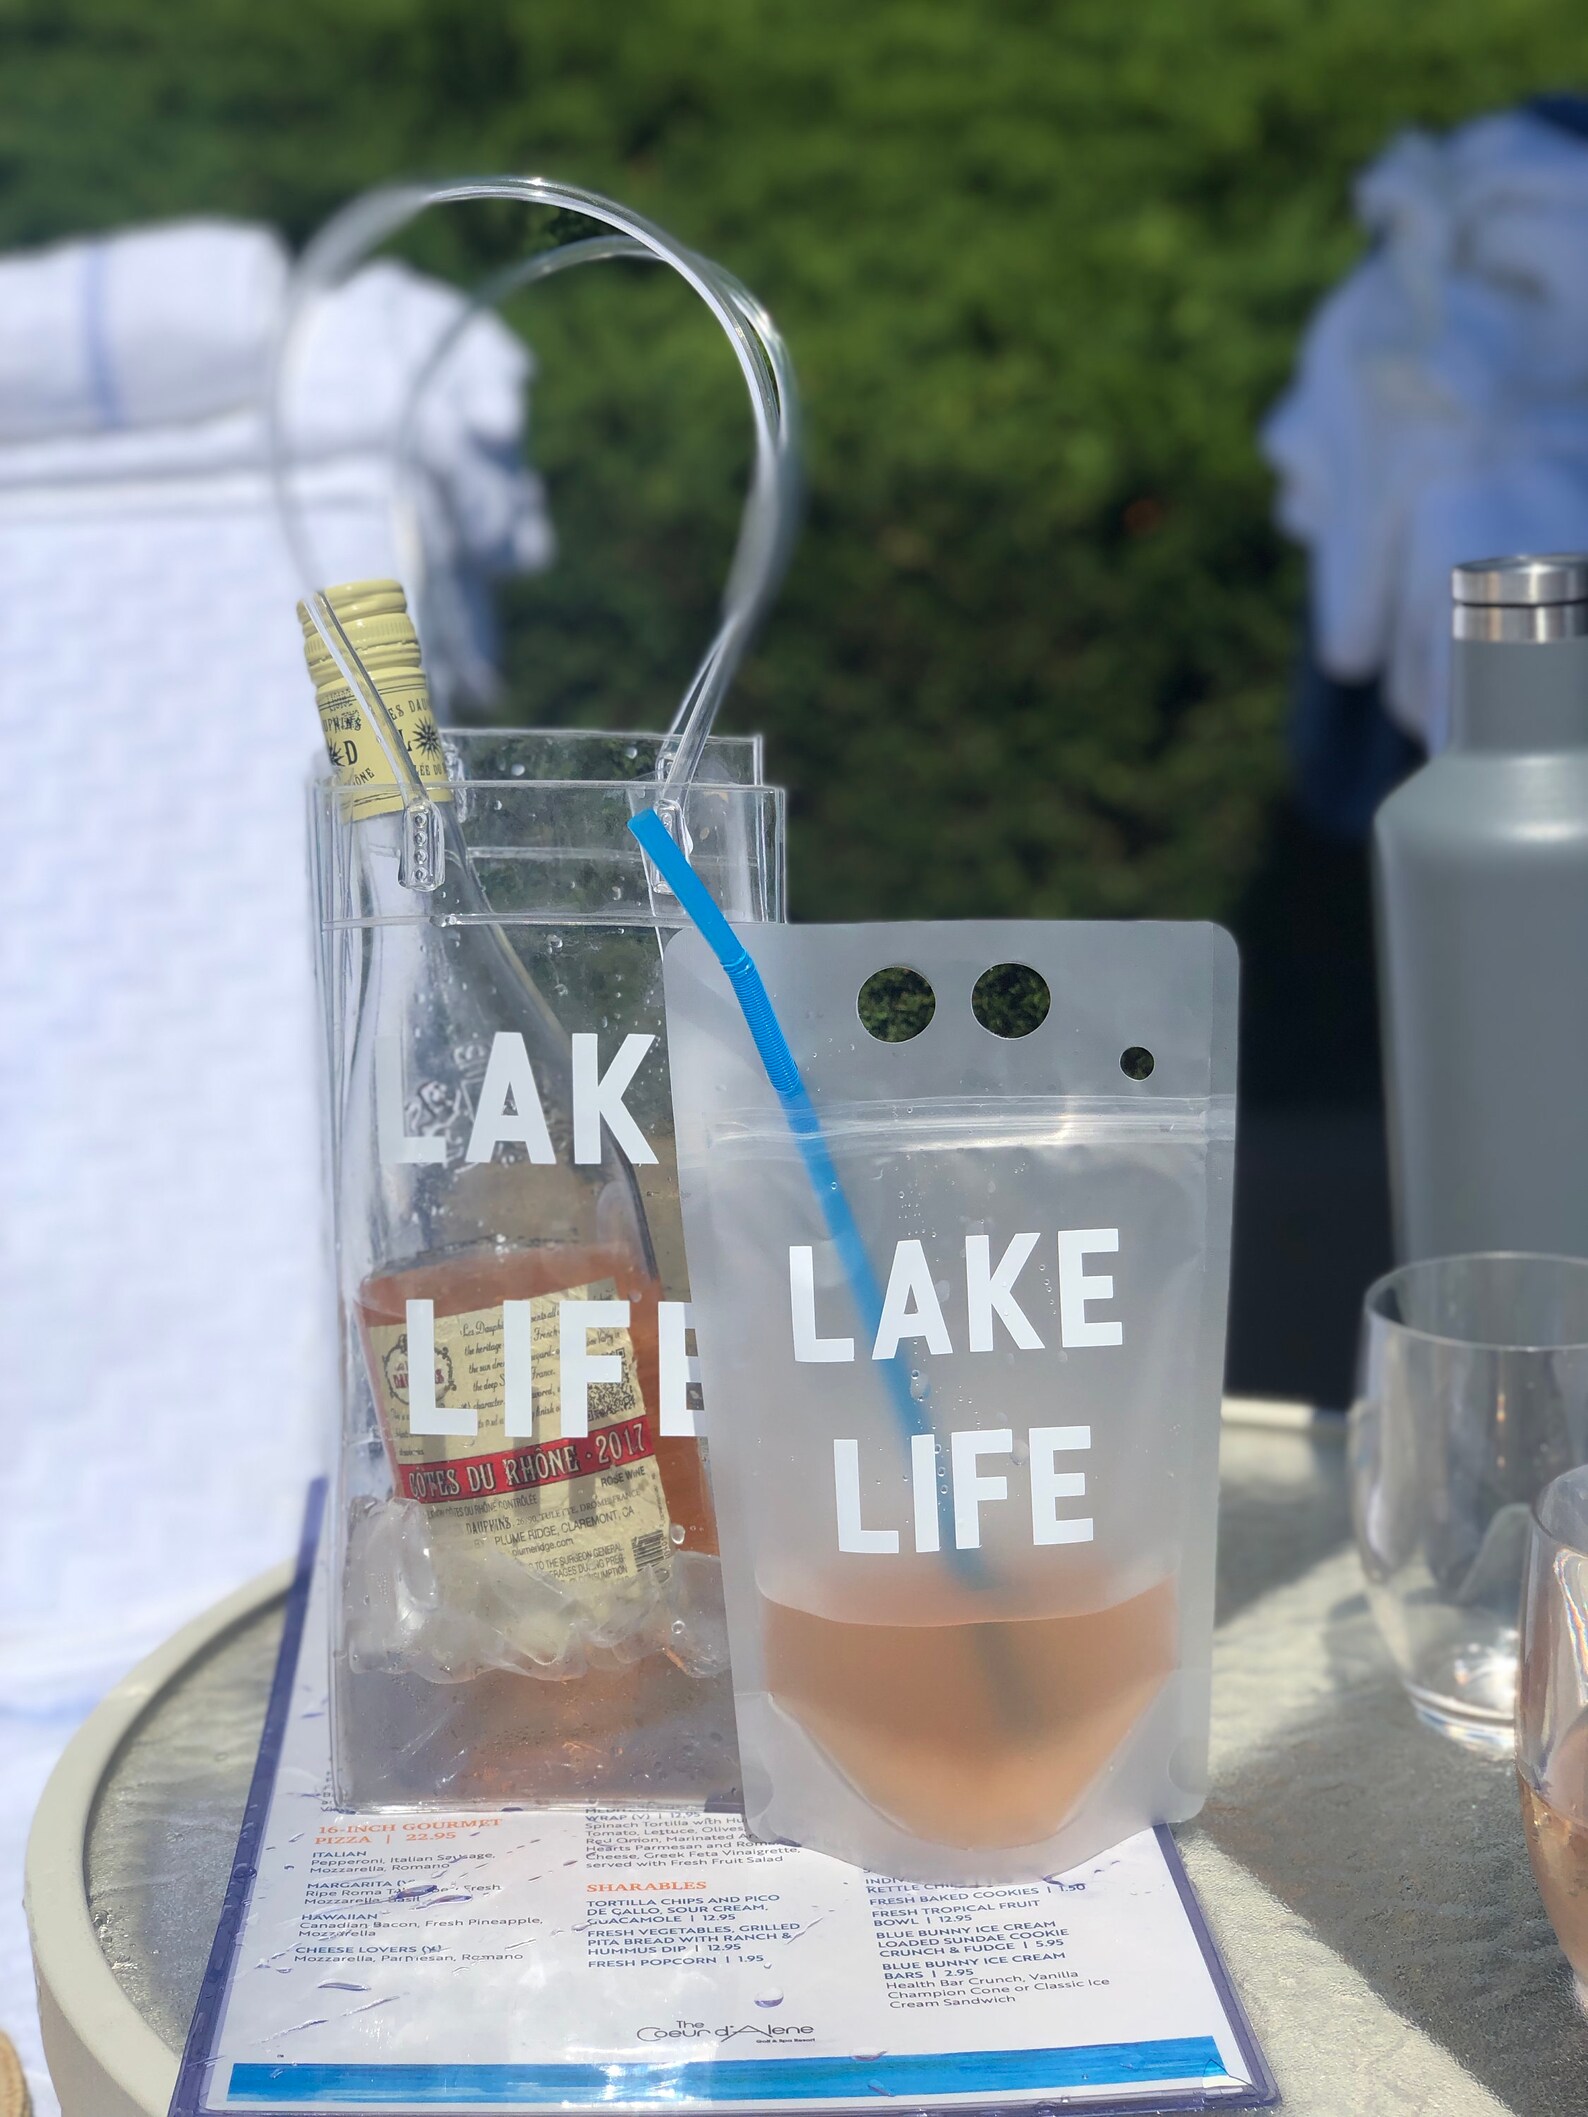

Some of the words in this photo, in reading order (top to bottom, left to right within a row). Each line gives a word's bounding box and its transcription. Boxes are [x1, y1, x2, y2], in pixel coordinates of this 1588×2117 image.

[789, 1228, 1123, 1363] LAKE
[466, 1462, 496, 1492] DU
[502, 1445, 579, 1486] RHÔNE
[595, 1422, 645, 1464] 2017
[834, 1425, 1094, 1554] LIFE
[495, 1530, 527, 1546] PLUME
[528, 1525, 560, 1541] RIDGE,
[561, 1513, 621, 1534] CLAREMONT,
[622, 1504, 635, 1518] CA
[319, 1824, 396, 1834] 16-INCH
[402, 1819, 503, 1831] GOURMET
[585, 1822, 638, 1830] Spinach
[644, 1828, 698, 1836] Lettuce,
[314, 1835, 372, 1845] PIZZA
[406, 1831, 456, 1841] 22.95
[666, 1833, 734, 1842] Marinated
[586, 1852, 640, 1860] Cheese,
[644, 1851, 685, 1859] Greek
[722, 1847, 801, 1856] Vinaigrette,
[635, 1843, 702, 1851] Parmesan
[310, 1865, 387, 1873] Mozzarella,
[392, 1862, 450, 1871] Romano
[311, 1856, 385, 1867] Pepperoni,
[390, 1855, 433, 1863] Italian
[671, 1858, 707, 1866] Fresh
[307, 1881, 392, 1889] MARGARITA
[586, 1881, 707, 1893] SHARABLES
[866, 1884, 920, 1893] KETTLE
[305, 1889, 337, 1898] Ripe
[869, 1897, 915, 1906] FRESH
[920, 1893, 969, 1903] BAKED
[973, 1887, 1040, 1899] COOKIES
[586, 1899, 657, 1907] TORTILLA
[661, 1897, 703, 1905] CHIPS
[744, 1894, 780, 1902] PICO
[587, 1907, 607, 1916] DE
[612, 1907, 663, 1916] GALLO,
[667, 1905, 708, 1914] SOUR
[713, 1903, 769, 1912] CREAM,
[872, 1908, 918, 1918] FRESH
[923, 1904, 996, 1916] TROPICAL
[999, 1899, 1041, 1909] FRUIT
[300, 1921, 368, 1929] Canadian
[468, 1917, 543, 1926] Pineapple,
[587, 1915, 682, 1925] GUACAMOLE
[702, 1913, 736, 1921] 12.95
[873, 1918, 920, 1927] BOWL
[939, 1914, 972, 1923] 12.95
[588, 1929, 634, 1937] FRESH
[638, 1926, 735, 1936] VEGETABLES,
[739, 1923, 800, 1932] GRILLED
[876, 1930, 913, 1939] BLUE
[918, 1926, 971, 1937] BUNNY
[976, 1925, 1000, 1933] ICE
[1003, 1921, 1057, 1931] CREAM
[624, 1936, 674, 1945] BREAD
[678, 1935, 719, 1943] WITH
[723, 1932, 777, 1941] RANCH
[781, 1932, 793, 1940] &
[878, 1938, 940, 1948] LOADED
[943, 1933, 1005, 1945] SUNDAE
[1009, 1928, 1070, 1940] COOKIE
[588, 1946, 657, 1955] HUMMUS
[662, 1945, 686, 1953] DIP
[707, 1943, 741, 1951] 12.95
[879, 1947, 945, 1958] CRUNCH
[950, 1945, 960, 1954] &
[964, 1942, 1015, 1952] FUDGE
[1035, 1938, 1064, 1948] 5.95
[588, 1959, 635, 1967] FRESH
[641, 1956, 716, 1966] POPCORN
[738, 1955, 764, 1963] 1.95
[882, 1961, 920, 1971] BLUE
[925, 1958, 979, 1968] BUNNY
[984, 1955, 1009, 1965] ICE
[1012, 1952, 1067, 1963] CREAM
[884, 1971, 924, 1980] BARS
[944, 1968, 974, 1977] 2.95
[886, 1980, 936, 1990] Health
[940, 1978, 964, 1987] Bar
[968, 1974, 1026, 1986] Crunch,
[1028, 1970, 1079, 1981] Vanilla
[888, 1988, 966, 2000] Champion
[970, 1985, 1010, 1994] Cone
[1014, 1984, 1030, 1992] or
[1034, 1980, 1084, 1991] Classic
[1088, 1978, 1111, 1987] Ice
[889, 1999, 940, 2009] Cream
[943, 1995, 1016, 2007] Sandwich
[676, 2020, 704, 2029] The
[636, 2026, 711, 2042] Coeur
[714, 2024, 815, 2042] d'Alene
